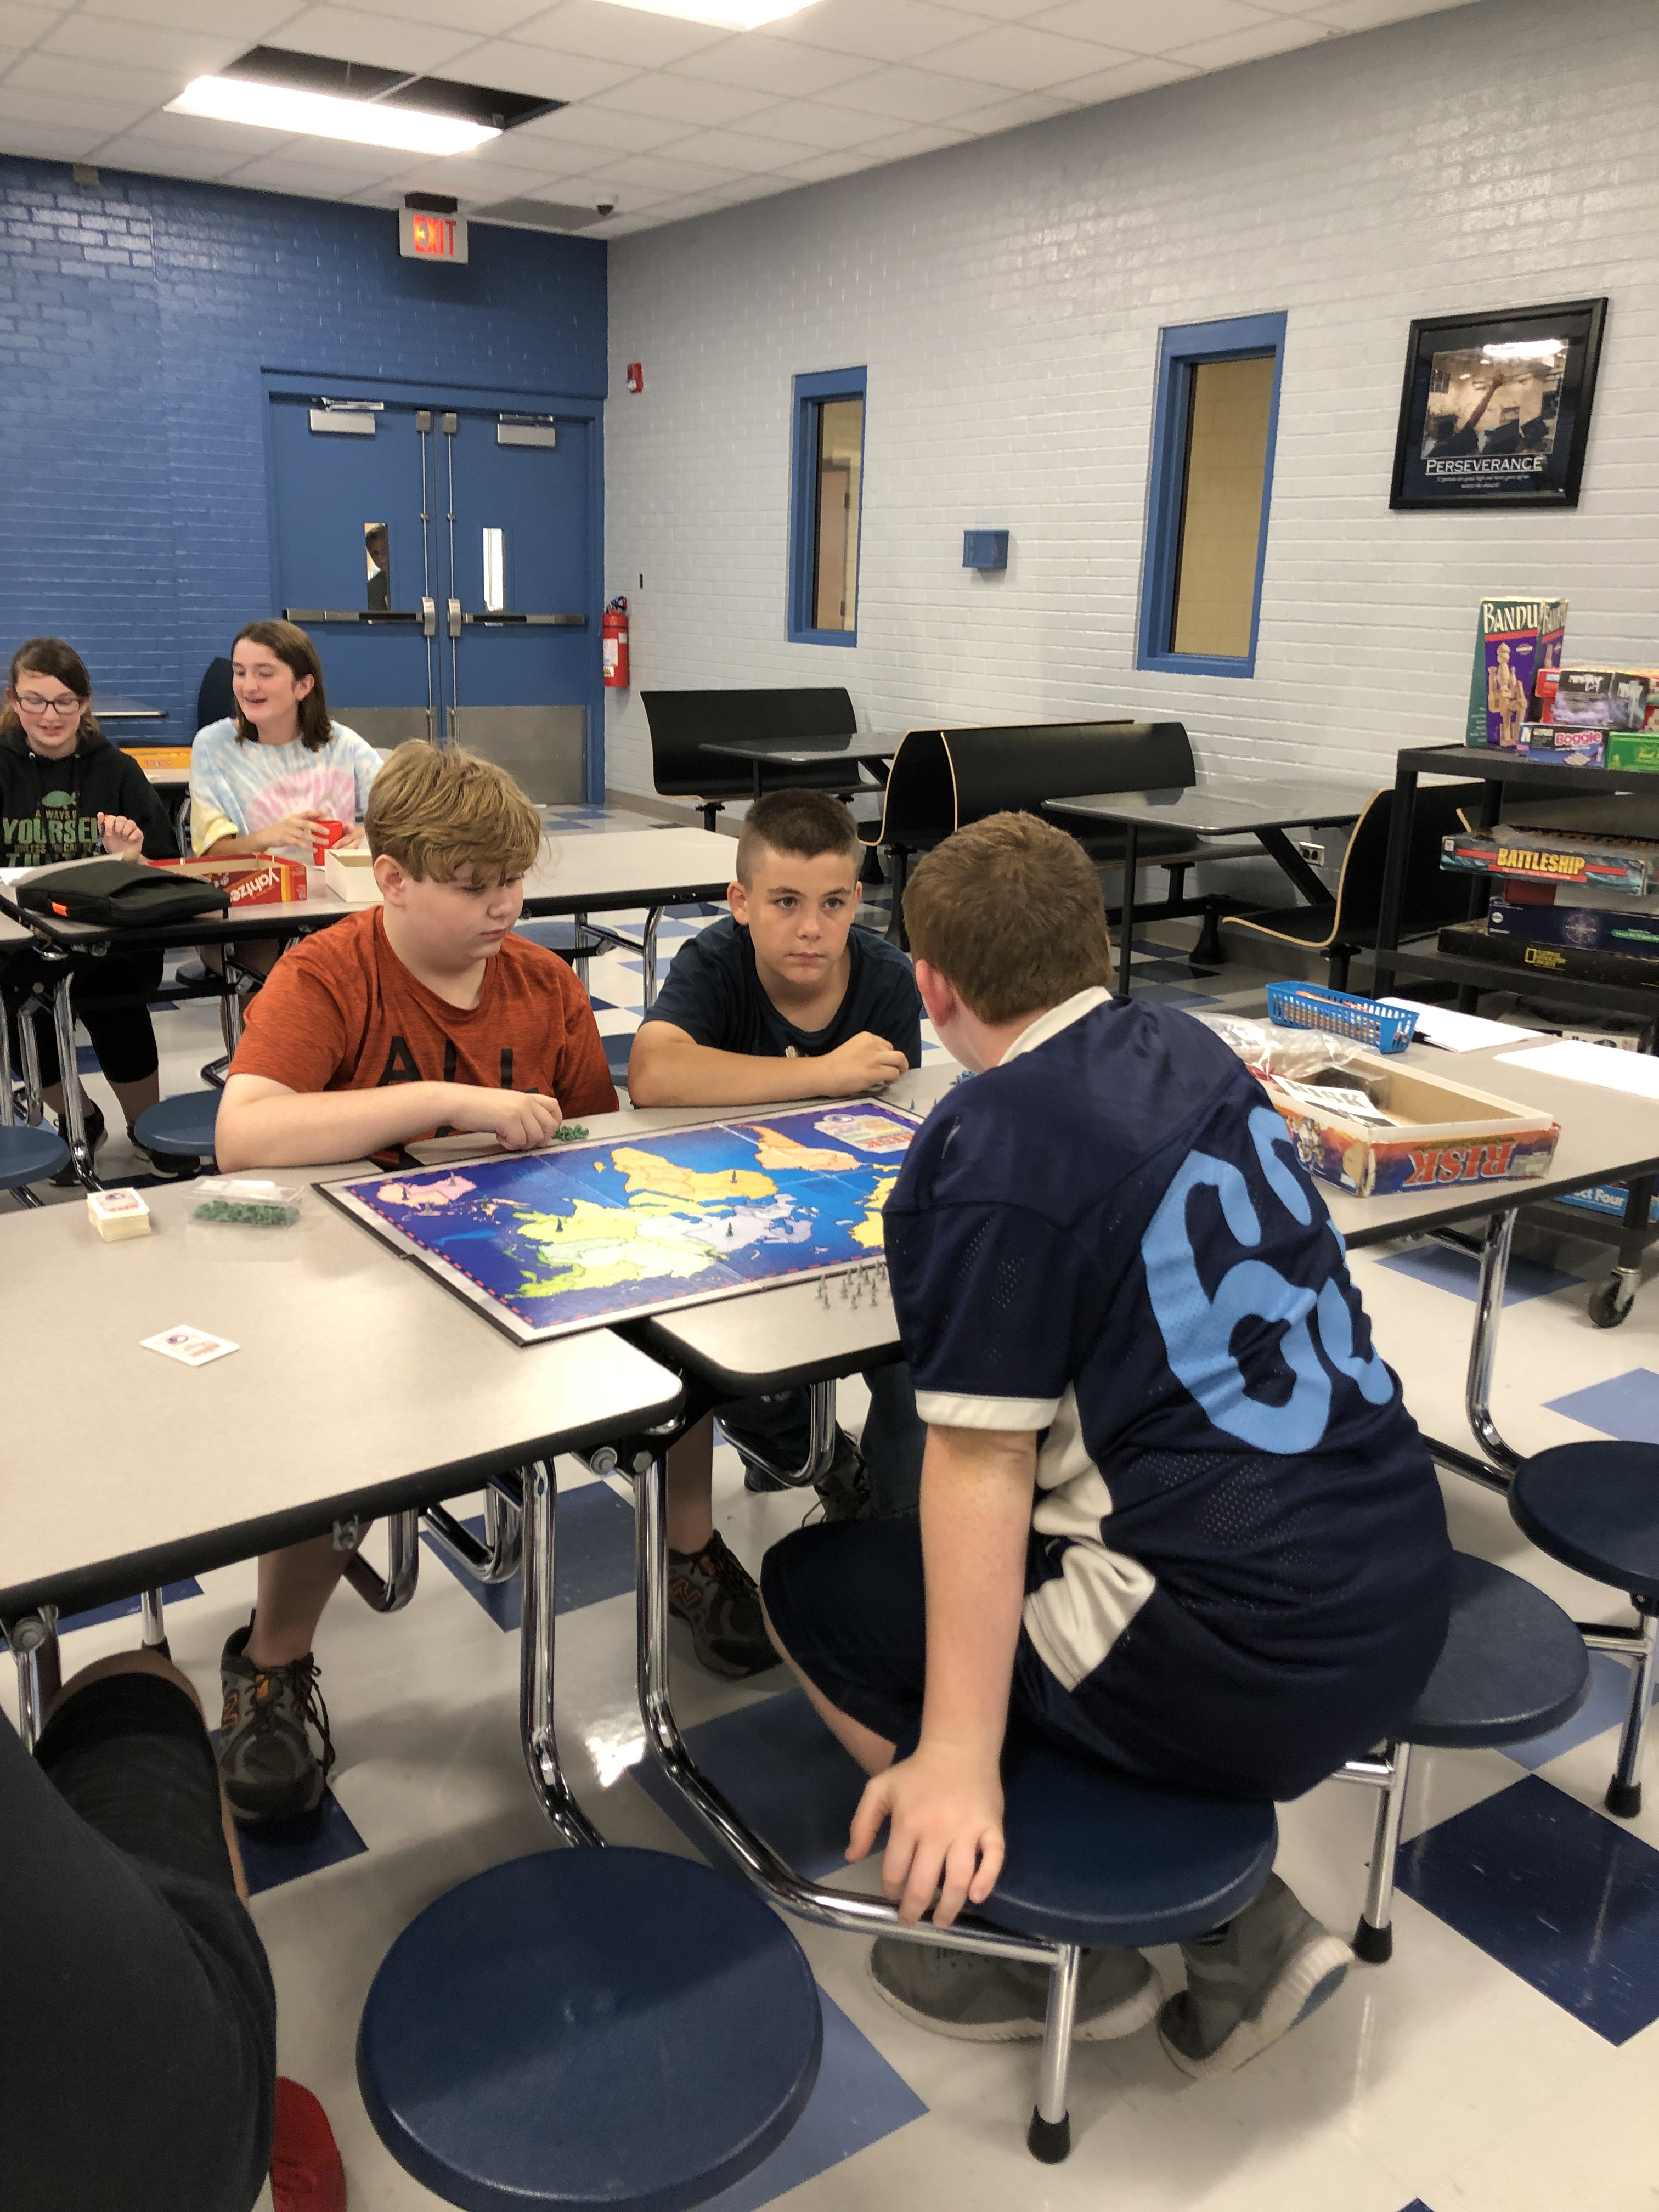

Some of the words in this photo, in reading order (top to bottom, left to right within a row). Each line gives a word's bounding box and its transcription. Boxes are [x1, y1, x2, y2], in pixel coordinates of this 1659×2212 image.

[414, 216, 456, 256] EXIT
[1426, 456, 1544, 473] PERSEVERANCE
[1483, 603, 1538, 634] BANDU
[1554, 731, 1602, 746] Boggle
[3, 816, 99, 845] YOURSEL
[1497, 848, 1585, 875] BATTLESHIP
[230, 867, 280, 902] Yahtze
[1403, 1143, 1516, 1187] RISK
[1595, 1188, 1625, 1206] Four
